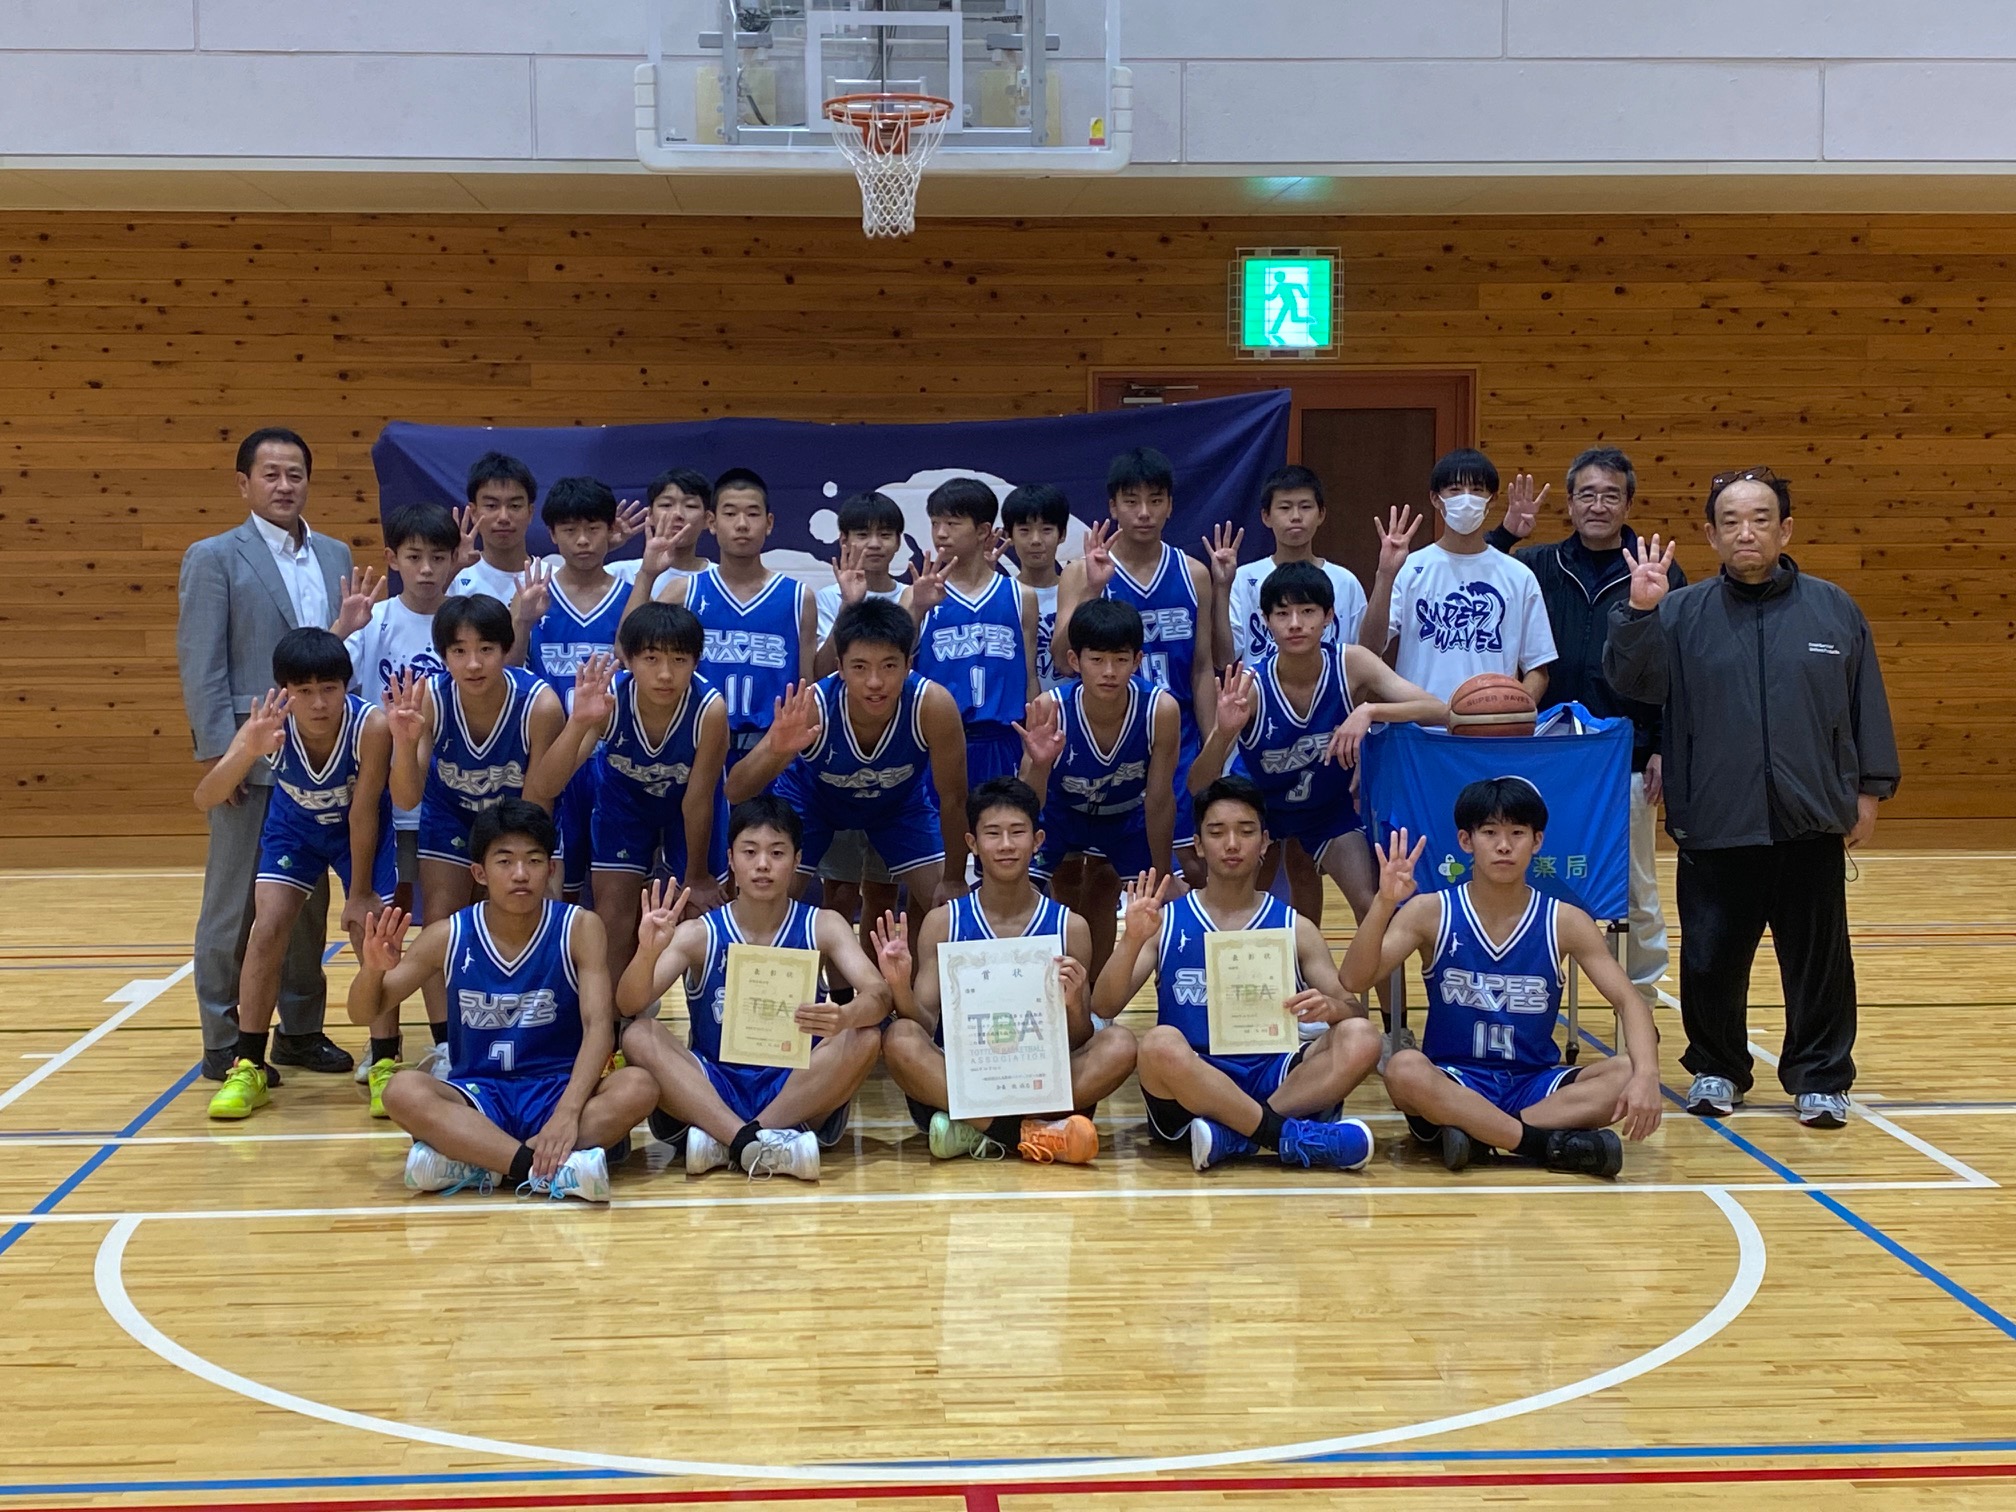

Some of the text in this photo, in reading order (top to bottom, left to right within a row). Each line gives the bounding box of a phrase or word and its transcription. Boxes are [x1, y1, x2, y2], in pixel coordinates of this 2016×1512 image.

[1142, 607, 1191, 624] PER
[932, 623, 1015, 644] SUPER
[932, 640, 1017, 662] WAVES
[725, 674, 753, 716] 11
[1533, 855, 1588, 879] 薬局
[1443, 968, 1547, 995] SUPER
[458, 988, 556, 1011] SUPER
[1440, 985, 1550, 1013] WAVES
[460, 1005, 558, 1030] WAVES
[967, 1010, 1044, 1045] TBA
[1473, 1020, 1515, 1060] 14
[488, 1040, 515, 1071] 7
